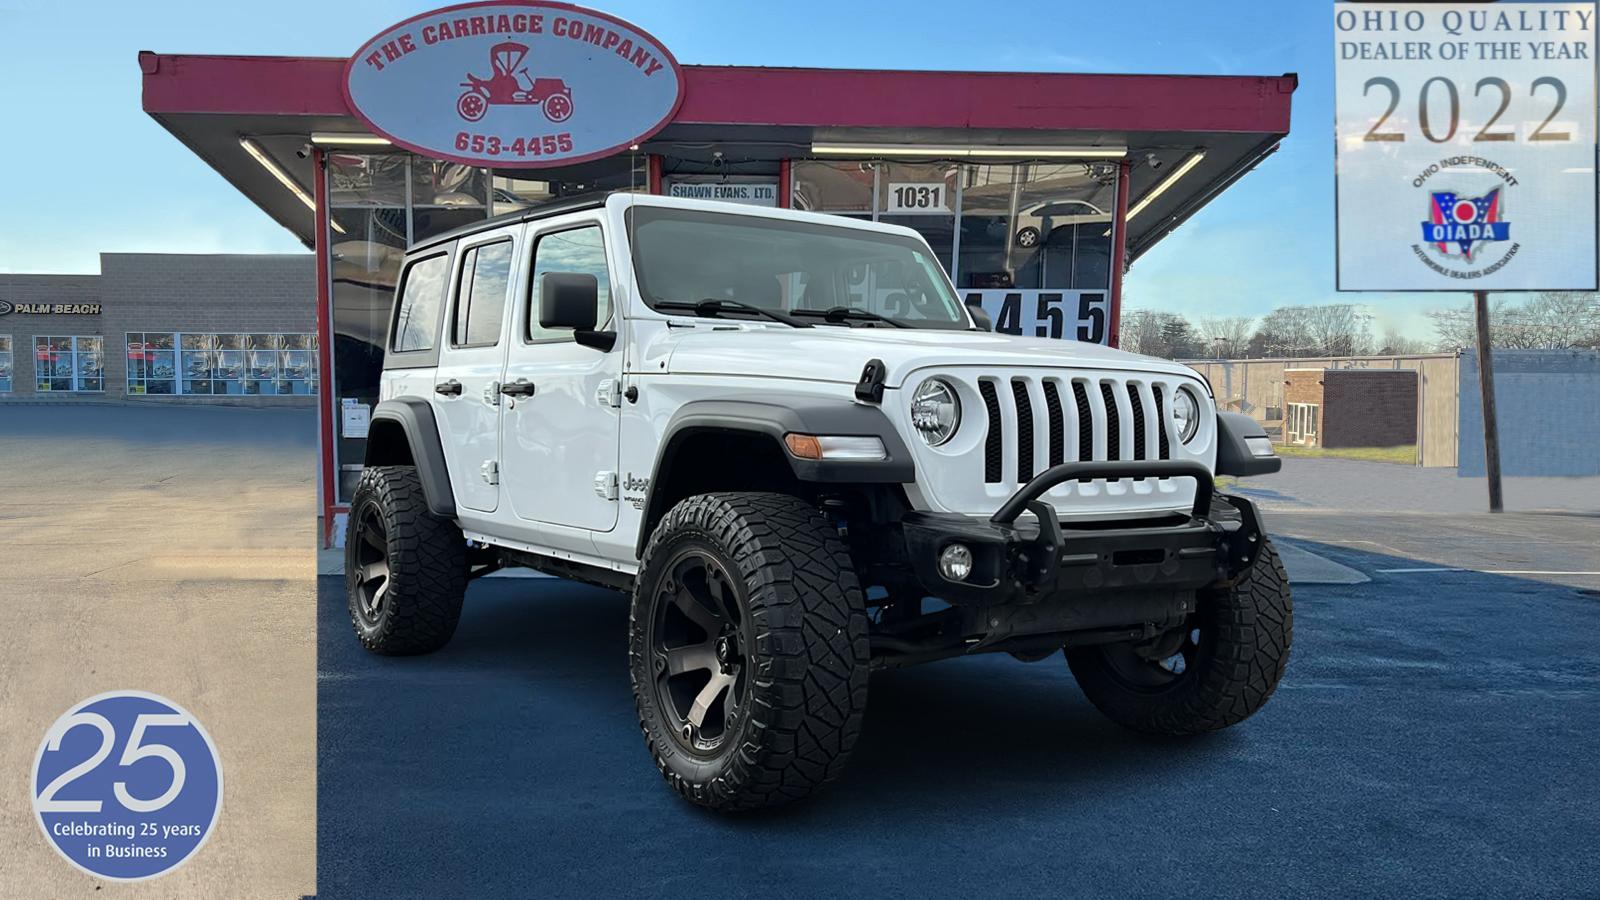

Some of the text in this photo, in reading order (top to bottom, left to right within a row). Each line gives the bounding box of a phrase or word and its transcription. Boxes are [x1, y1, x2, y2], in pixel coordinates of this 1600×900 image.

[1336, 10, 1593, 35] OHIO QUALITY
[365, 14, 664, 77] THE CARRIAGE COMPANY
[1340, 42, 1589, 60] DEALER OF THE YEAR
[1362, 76, 1571, 143] 2022
[454, 132, 573, 156] 653-4455
[1412, 155, 1519, 188] OHIO INDEPENDENT
[672, 185, 775, 200] SHAWN EVANS. LTD.
[894, 186, 940, 208] 1031
[1432, 224, 1495, 241] OIADA
[1449, 270, 1482, 279] DEALERS
[14, 303, 100, 314] PALM BEACH
